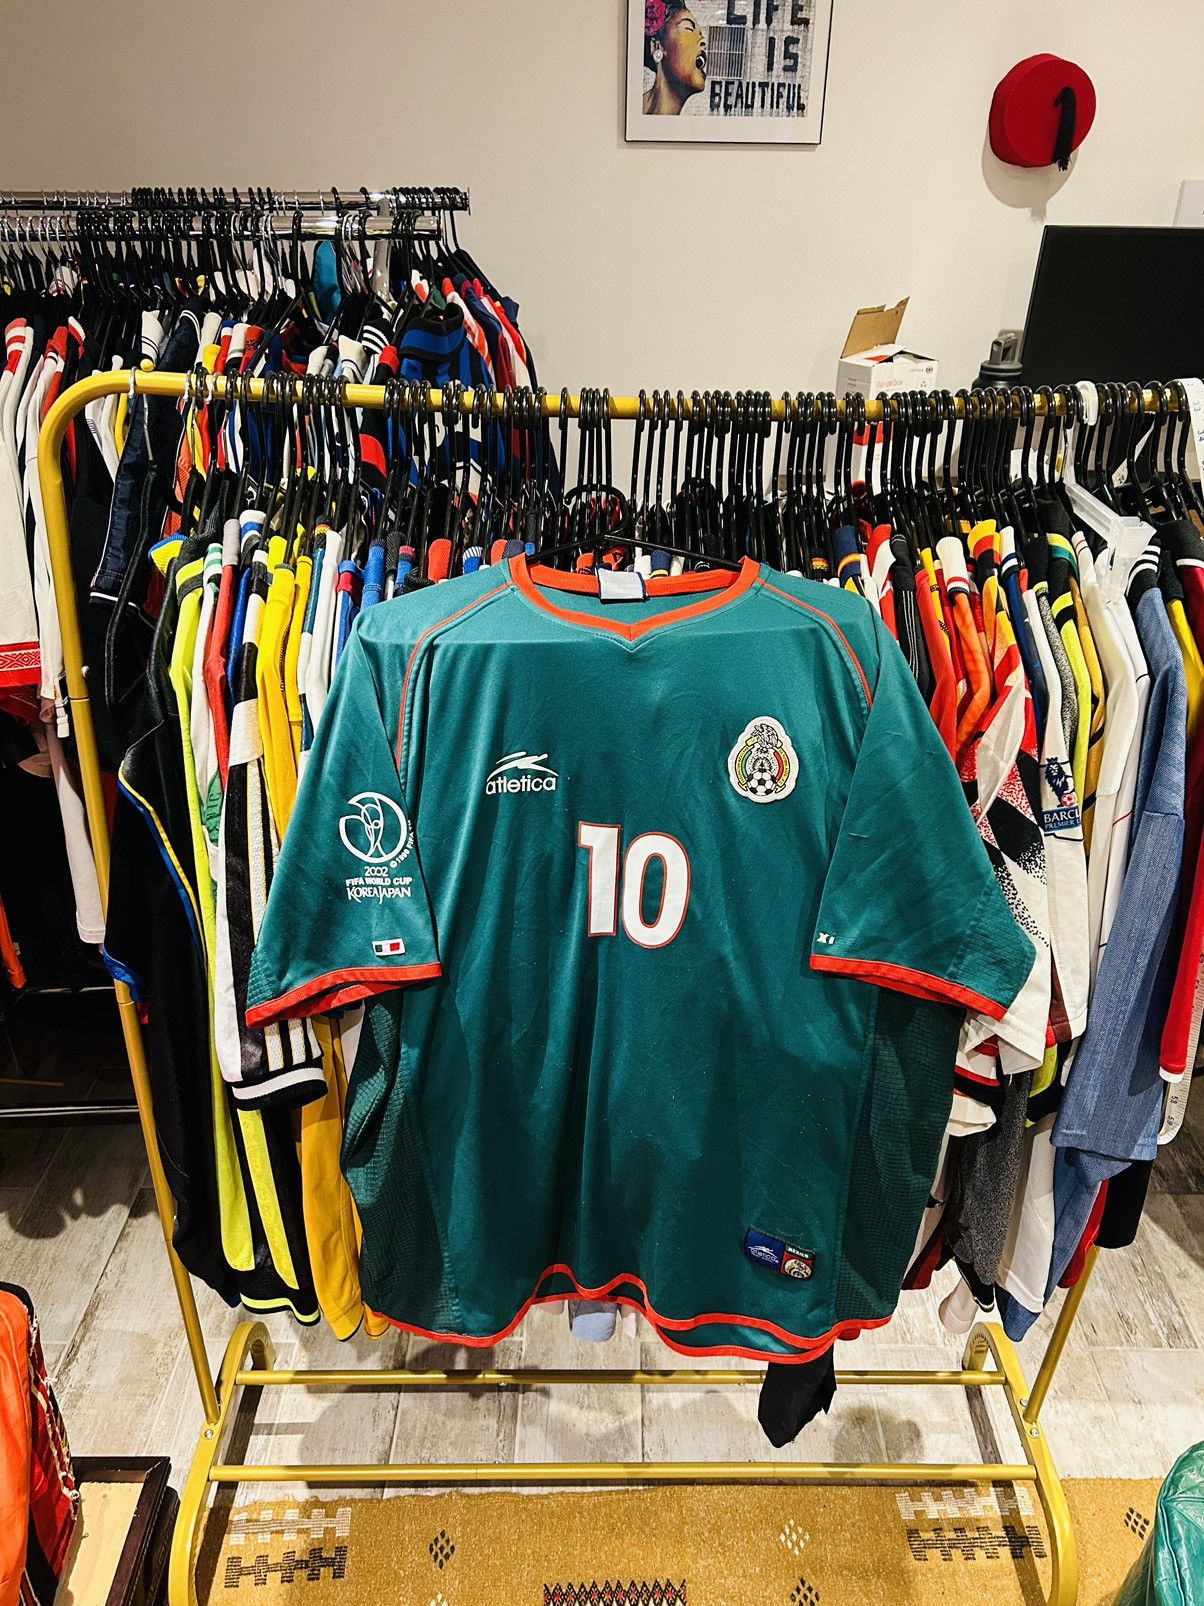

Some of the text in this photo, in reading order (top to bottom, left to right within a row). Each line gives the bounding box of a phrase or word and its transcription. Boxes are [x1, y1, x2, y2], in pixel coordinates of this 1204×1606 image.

[726, 0, 810, 28] LIFE
[767, 35, 800, 73] IS
[709, 80, 806, 112] BEAUTIFUL
[485, 774, 557, 795] atletica
[345, 877, 412, 886] FIFA WORLD CUP
[364, 866, 388, 876] 2002
[577, 821, 691, 949] 10
